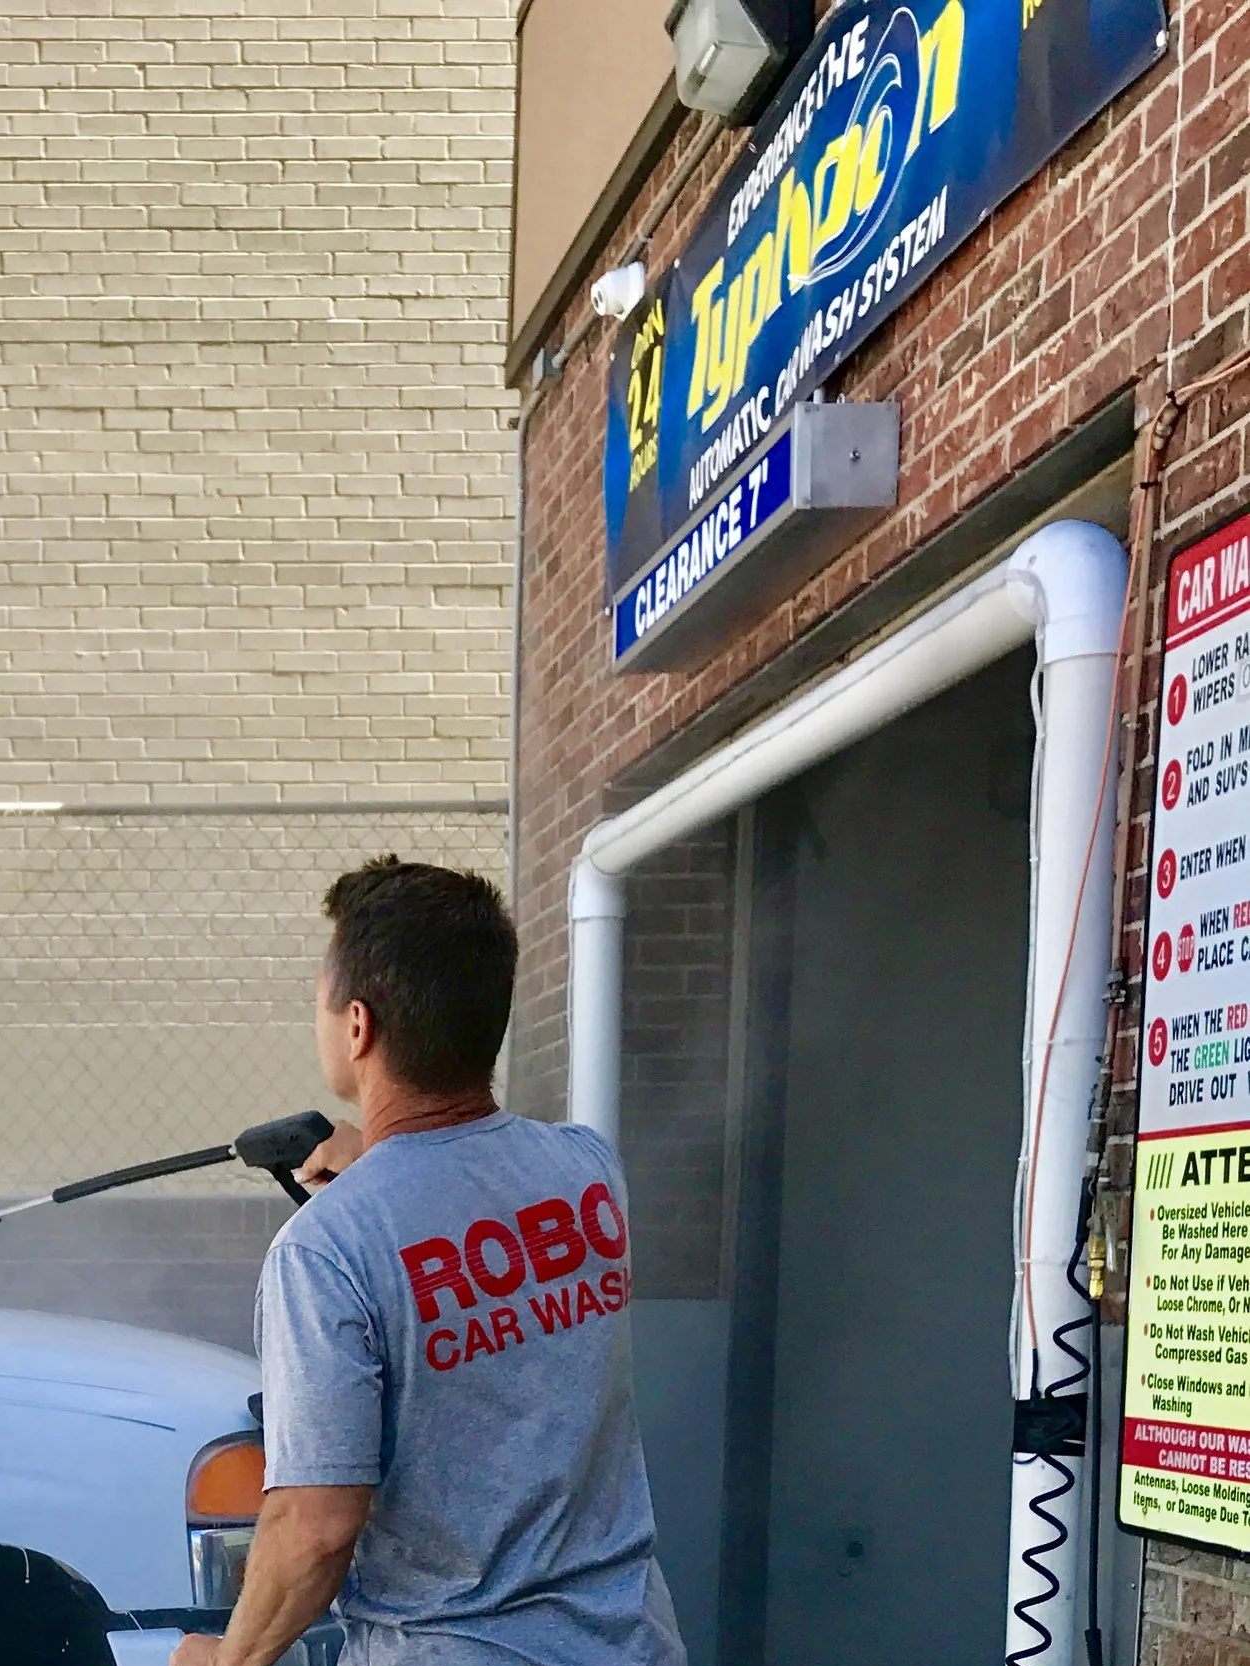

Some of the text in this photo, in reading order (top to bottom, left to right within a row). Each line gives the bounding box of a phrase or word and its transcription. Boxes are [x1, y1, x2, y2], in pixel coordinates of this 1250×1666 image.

[727, 15, 869, 248] EXPERIENCE THE
[688, 185, 948, 511] AUTOMATIC CAR WASH SYSTEM
[627, 345, 662, 453] 24
[635, 483, 743, 638] CLEARANCE
[1177, 555, 1216, 624] CAR
[1191, 642, 1229, 683] LOWER
[1193, 671, 1236, 715] WIPERS
[1186, 741, 1214, 775] FOLD
[1220, 731, 1233, 761] IN
[1186, 760, 1248, 808] AND SUV'S
[1179, 847, 1212, 881] ENTER
[1216, 833, 1246, 870] WHEN
[1200, 906, 1230, 938] WHEN
[1197, 939, 1235, 972] PLACE
[1171, 1012, 1200, 1042] WHEN
[1204, 1007, 1224, 1035] THE
[1226, 1003, 1248, 1031] RED
[1170, 1048, 1190, 1074] THE
[1194, 1040, 1230, 1069] GREEN
[1169, 1077, 1204, 1107] DRIVE
[1211, 1073, 1237, 1100] OUT
[1157, 1202, 1208, 1221] Oversized
[1162, 1221, 1248, 1240] Be Washed Here
[399, 1182, 626, 1323] ROBO
[1161, 1243, 1250, 1264] For Any Damage
[1153, 1275, 1166, 1291] Do
[1169, 1275, 1189, 1291] Not
[1192, 1275, 1213, 1292] Use
[1217, 1274, 1225, 1291] if
[1157, 1295, 1185, 1312] Loose
[1186, 1295, 1226, 1316] Chrome,
[1228, 1296, 1241, 1313] Or
[426, 1307, 524, 1371] CAR
[1149, 1323, 1163, 1339] Do
[1165, 1323, 1184, 1340] Not
[1186, 1325, 1215, 1341] Wash
[1155, 1343, 1248, 1365] Compressed Gas
[1147, 1373, 1174, 1391] Close
[1177, 1375, 1223, 1395] Windows
[1225, 1381, 1246, 1397] and
[1152, 1394, 1192, 1417] Washing
[1134, 1423, 1196, 1448] ALTHOUGH
[1199, 1432, 1225, 1450] OUR
[1158, 1449, 1207, 1473] CANNOT
[1209, 1457, 1226, 1475] BE
[1134, 1470, 1179, 1494] Antennas,
[1182, 1478, 1210, 1498] Loose
[1166, 1500, 1176, 1512] or
[1178, 1499, 1217, 1523] Damage
[1220, 1508, 1239, 1526] Due
